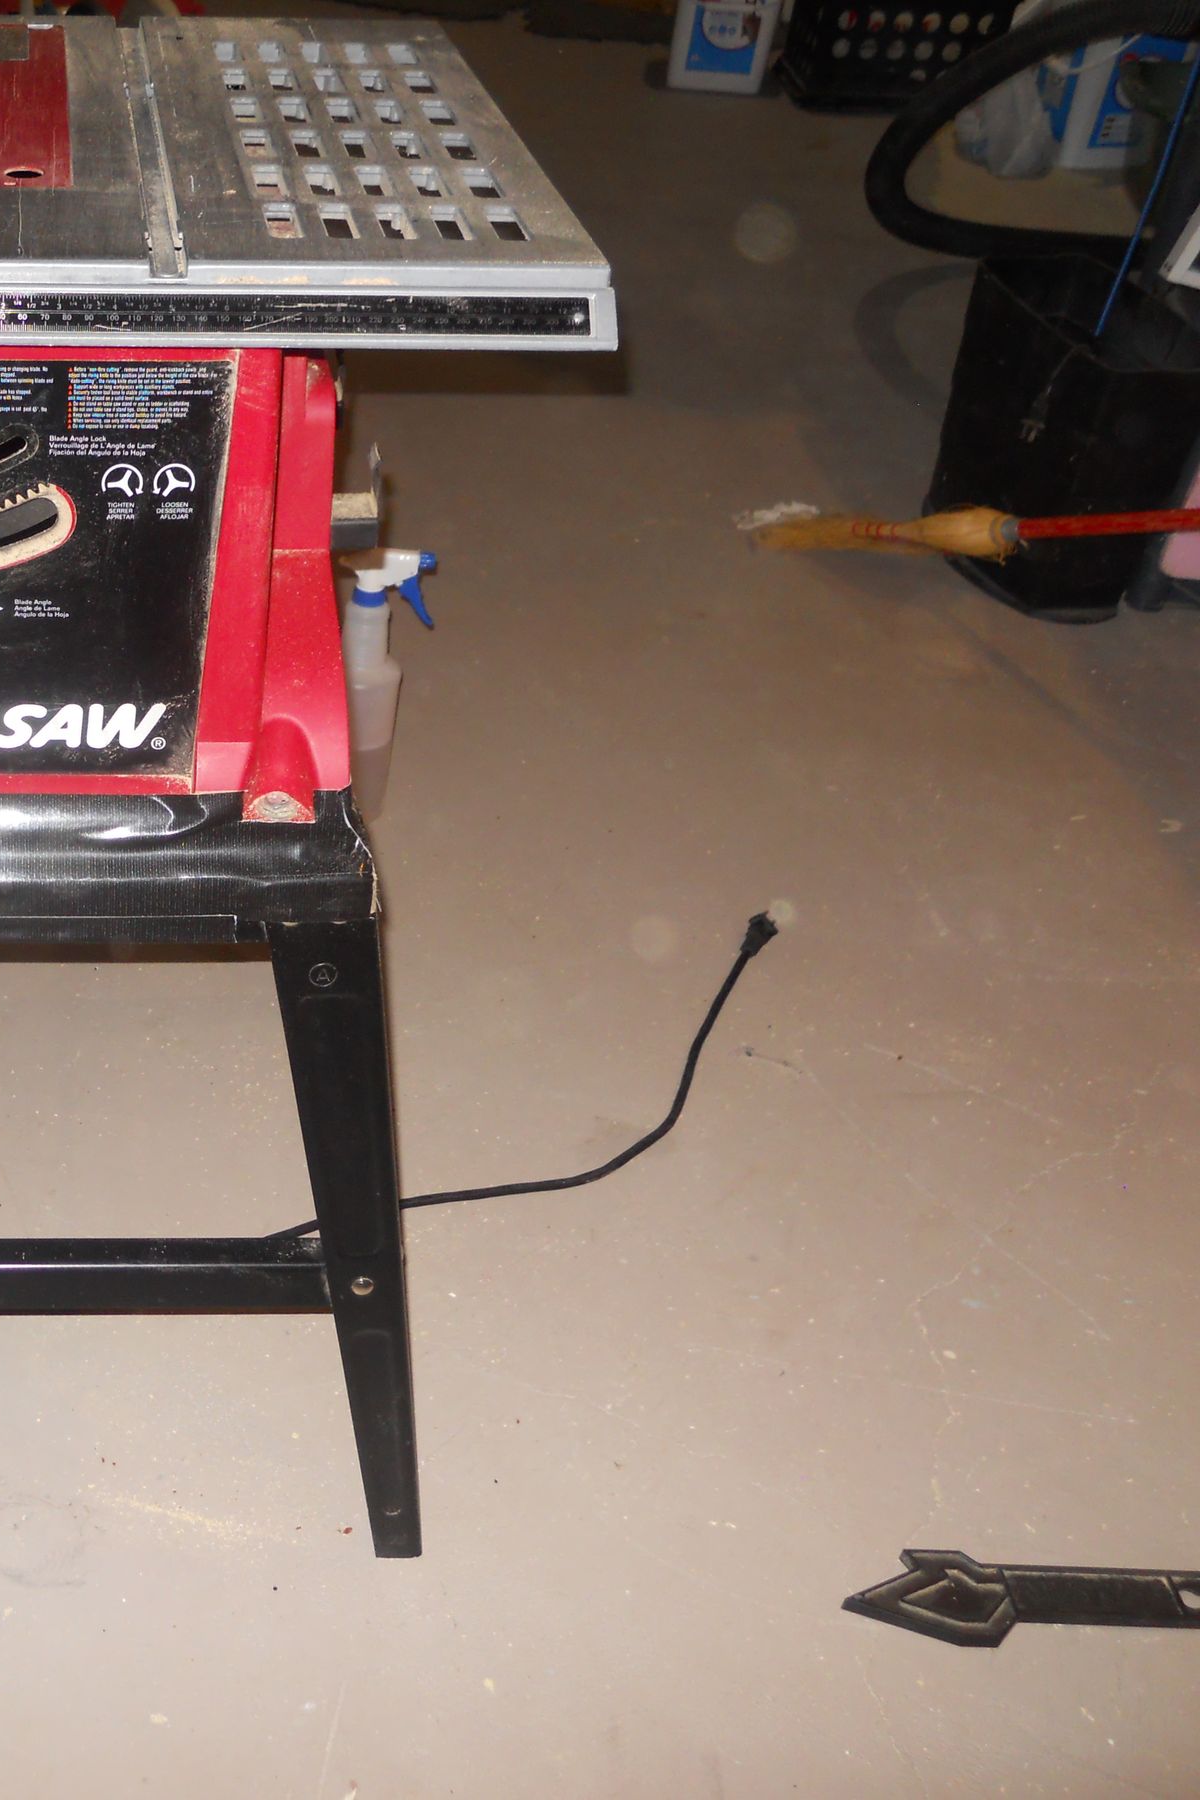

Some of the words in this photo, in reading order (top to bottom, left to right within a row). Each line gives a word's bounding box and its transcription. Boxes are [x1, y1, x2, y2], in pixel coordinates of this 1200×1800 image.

[70, 435, 89, 443] Angle
[49, 442, 89, 450] Verrouillage
[100, 442, 126, 450] L'Angle
[49, 448, 75, 457] Fijación
[76, 448, 87, 456] del
[131, 449, 146, 457] Hoja
[33, 598, 52, 606] Angle
[54, 611, 69, 619] Hoja
